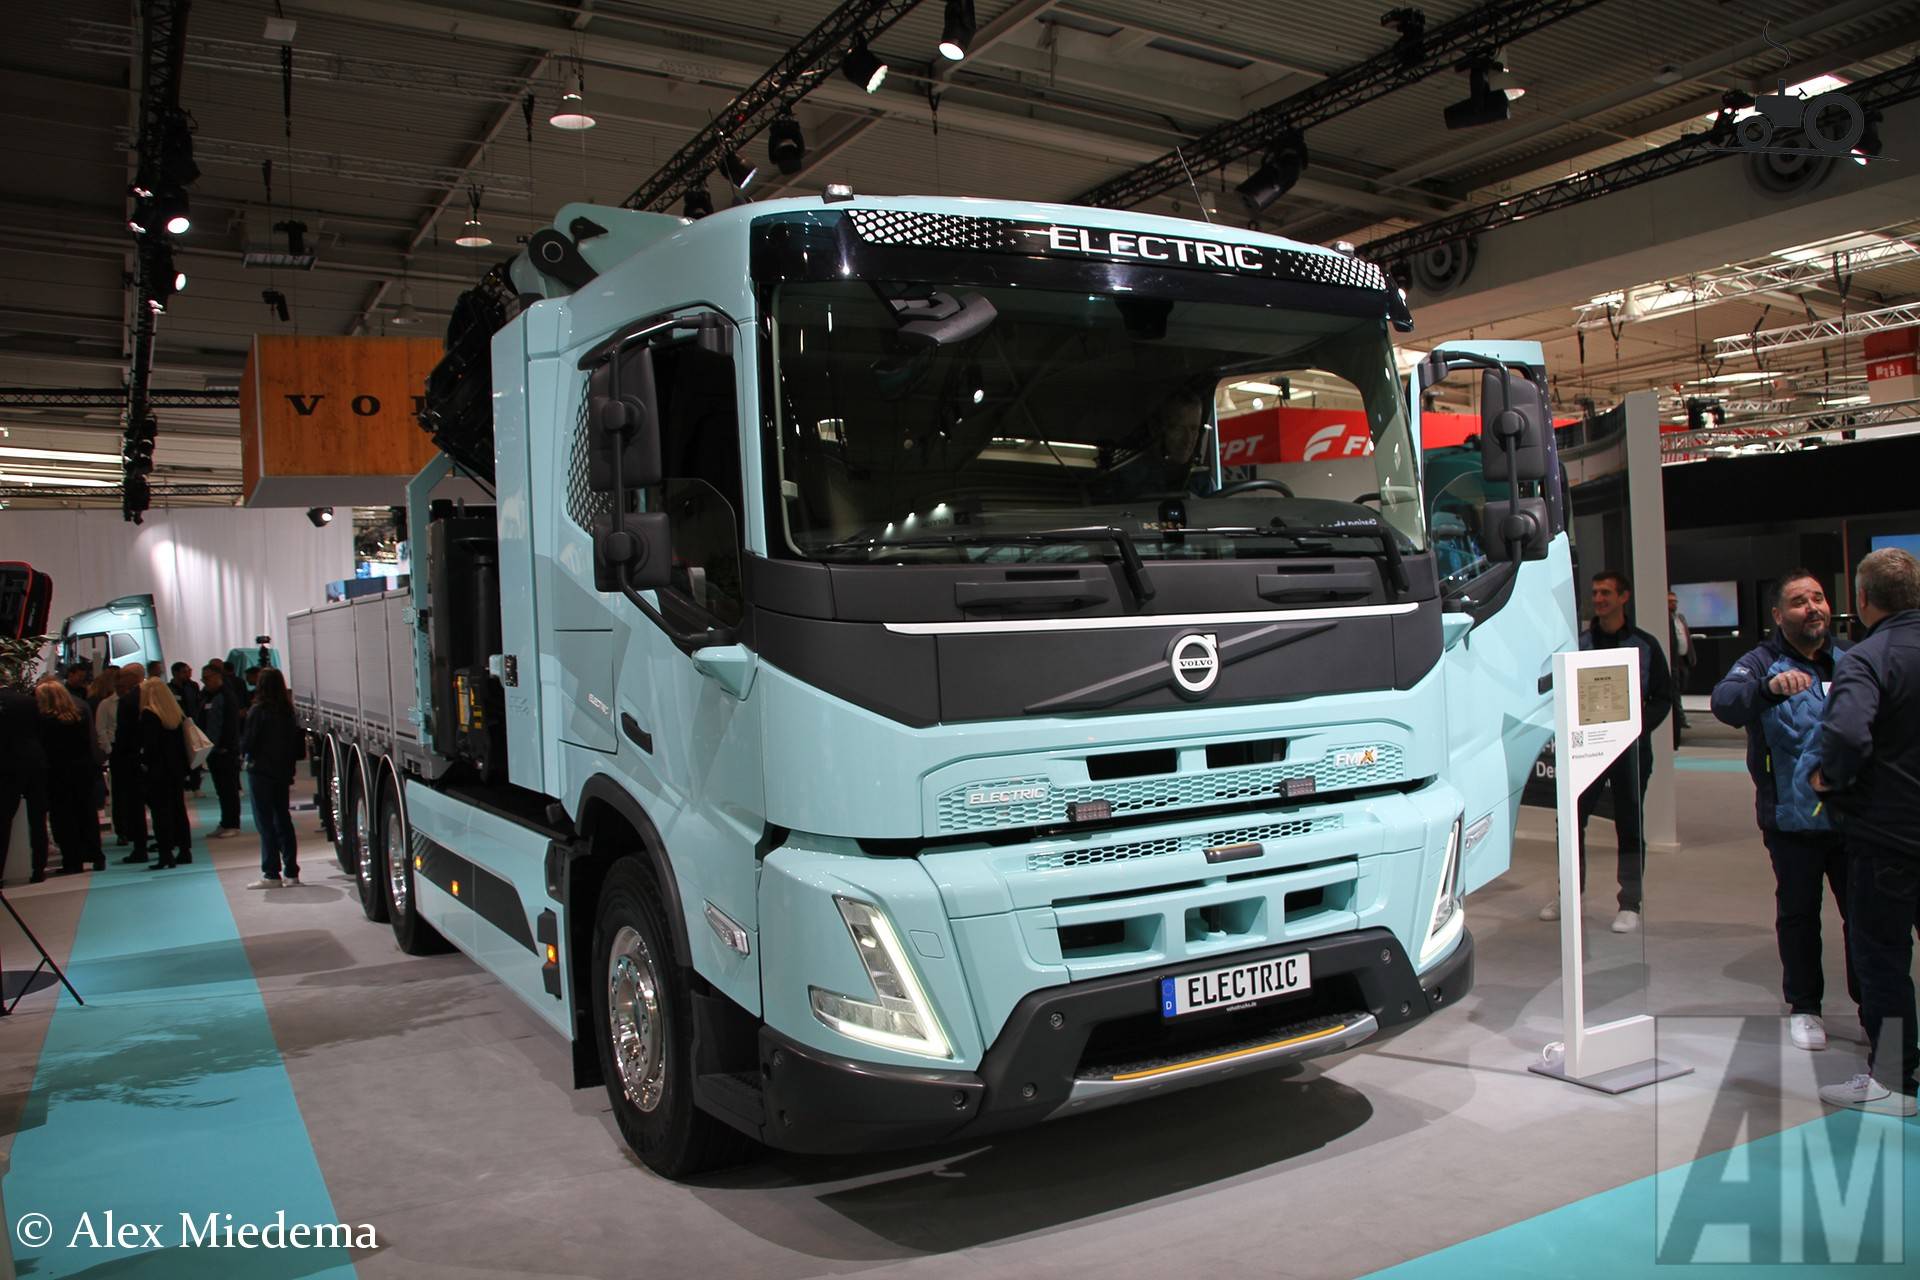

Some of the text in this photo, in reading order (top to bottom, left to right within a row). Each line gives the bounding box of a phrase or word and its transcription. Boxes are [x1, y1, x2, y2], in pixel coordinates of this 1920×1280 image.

[1050, 226, 1264, 270] ELECTRIC
[1180, 659, 1213, 667] VOLVO
[1335, 748, 1377, 767] FMX
[969, 787, 1046, 805] ELECTRIC
[1188, 959, 1298, 1008] ELECTRIC
